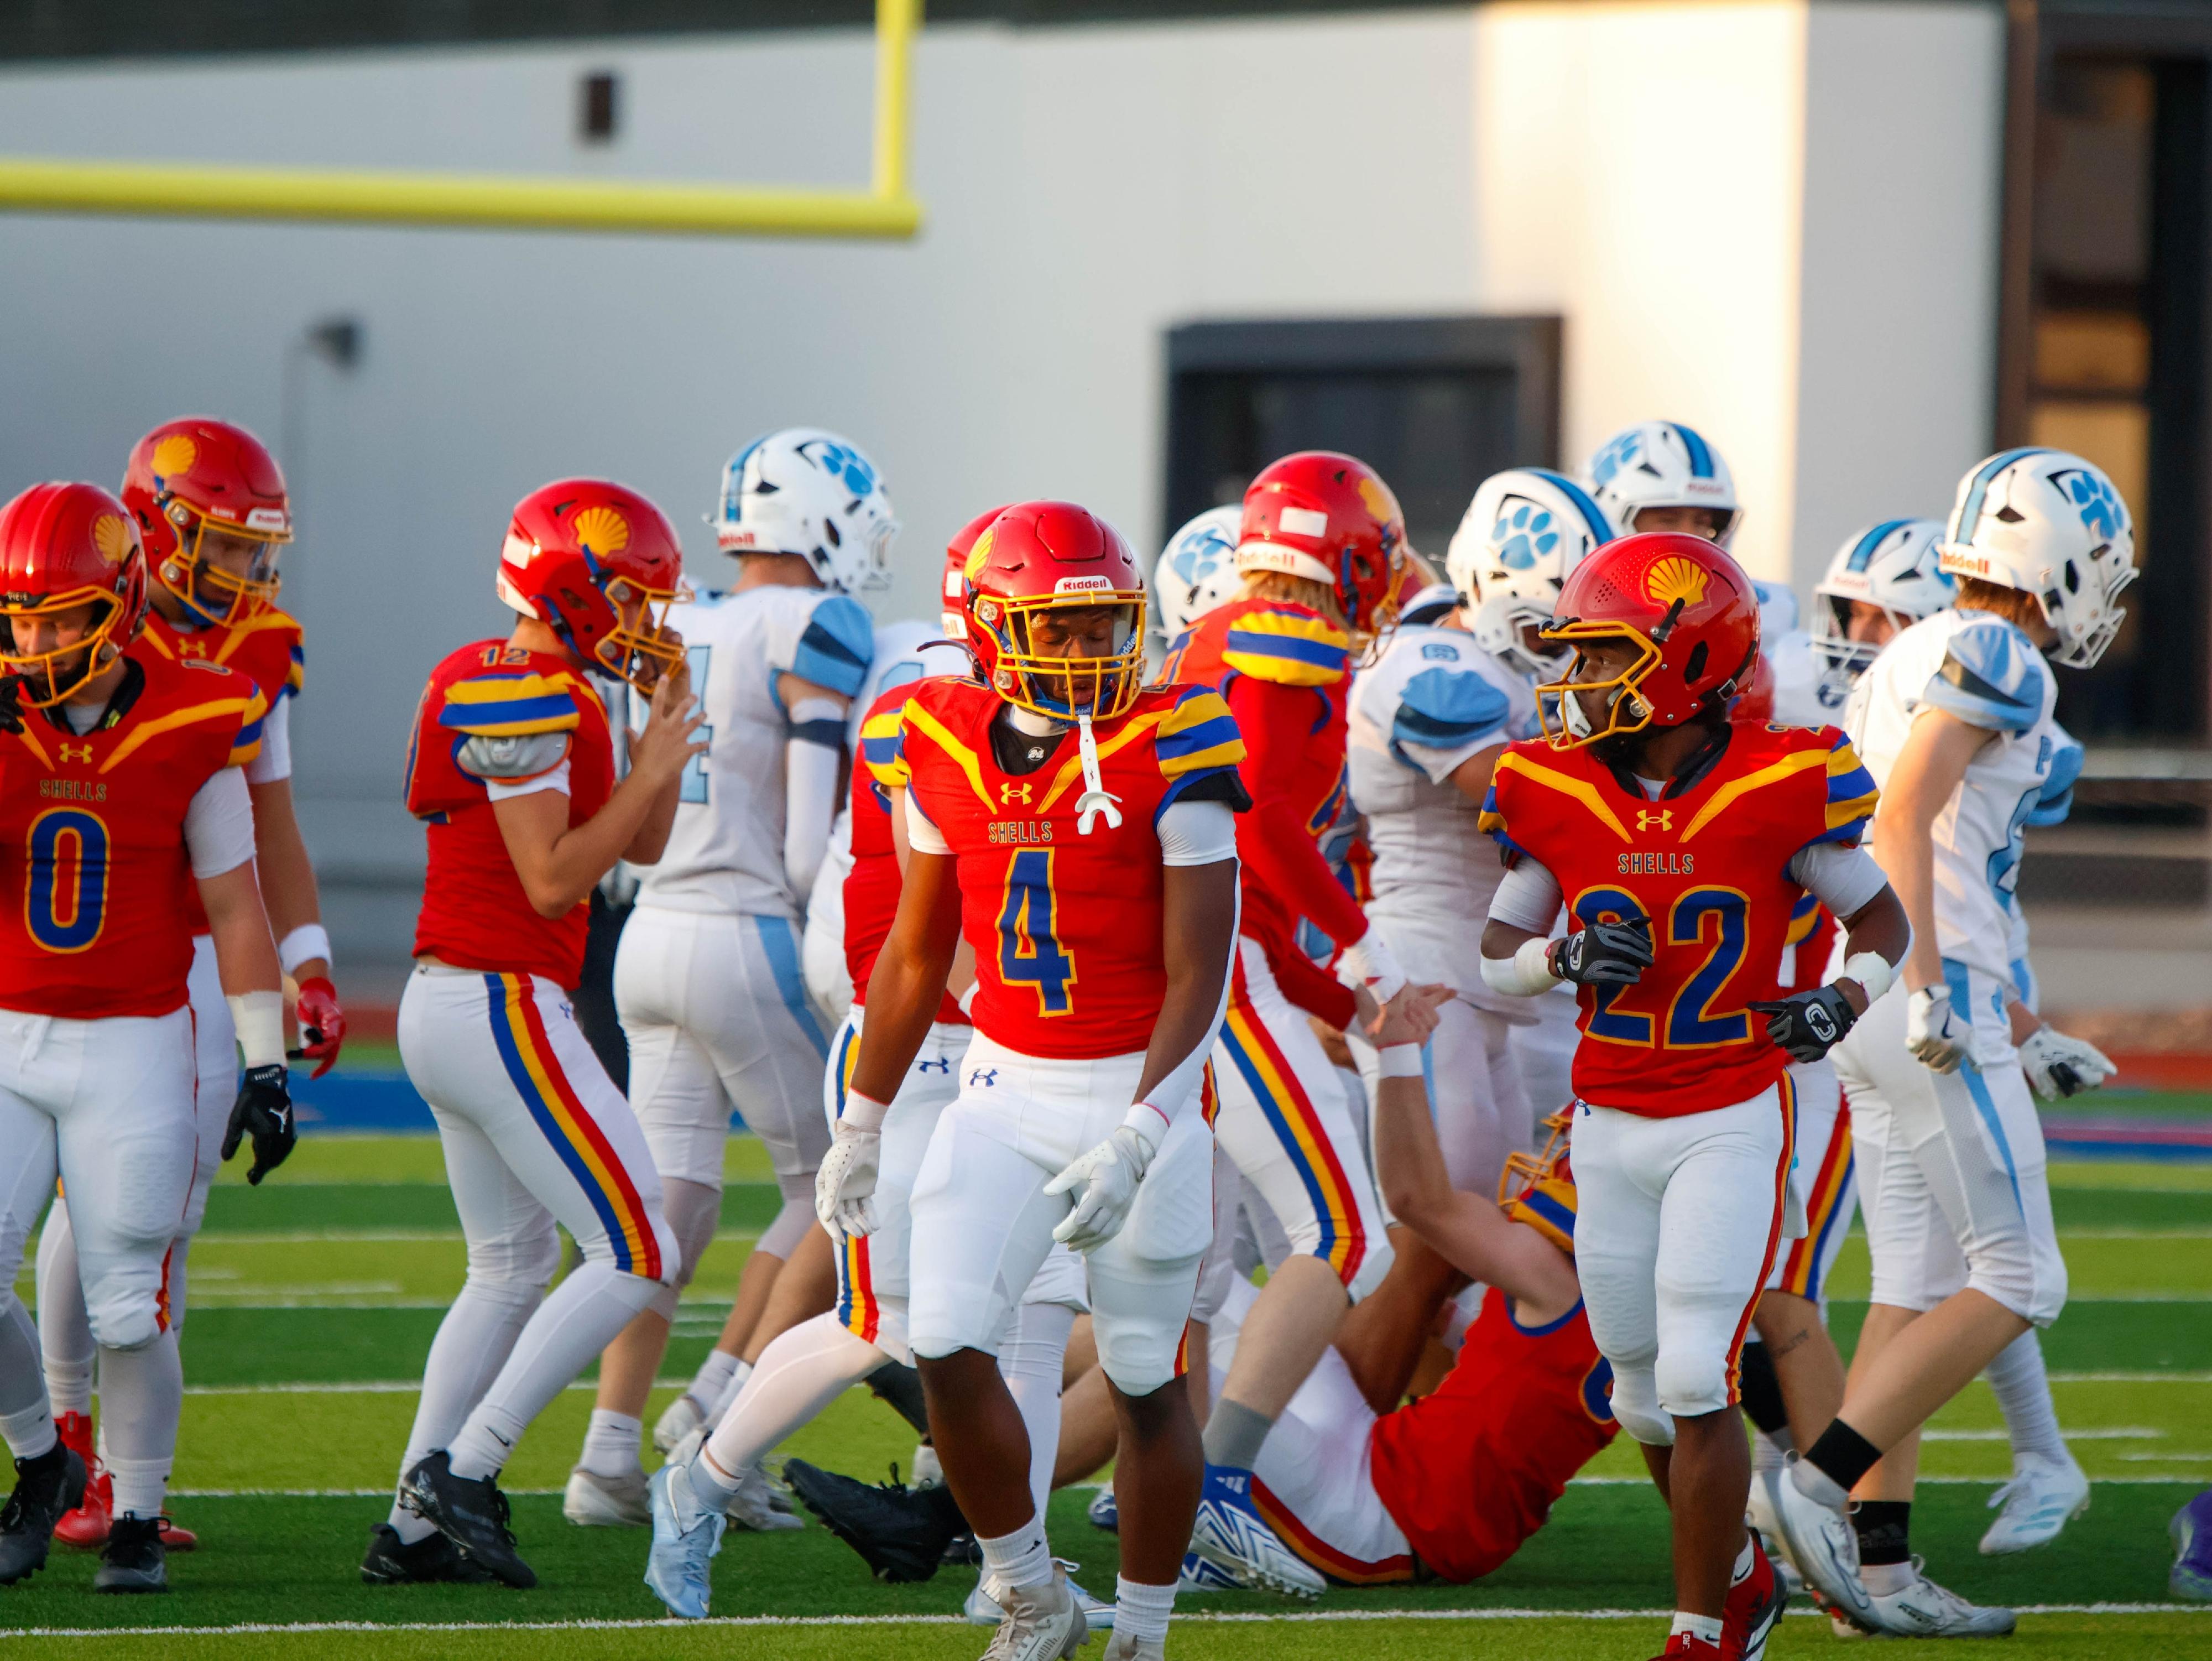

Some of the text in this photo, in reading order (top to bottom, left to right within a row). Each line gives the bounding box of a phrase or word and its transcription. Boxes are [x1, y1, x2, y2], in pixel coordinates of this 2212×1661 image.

[1063, 579, 1107, 591] Riddell
[479, 645, 531, 667] 12
[39, 779, 108, 802] SHELLS
[988, 821, 1053, 843] SHELLS
[1618, 853, 1694, 874] SHELLS
[24, 806, 111, 954] 0
[995, 847, 1078, 1018] 4
[1571, 884, 1754, 1050] 22
